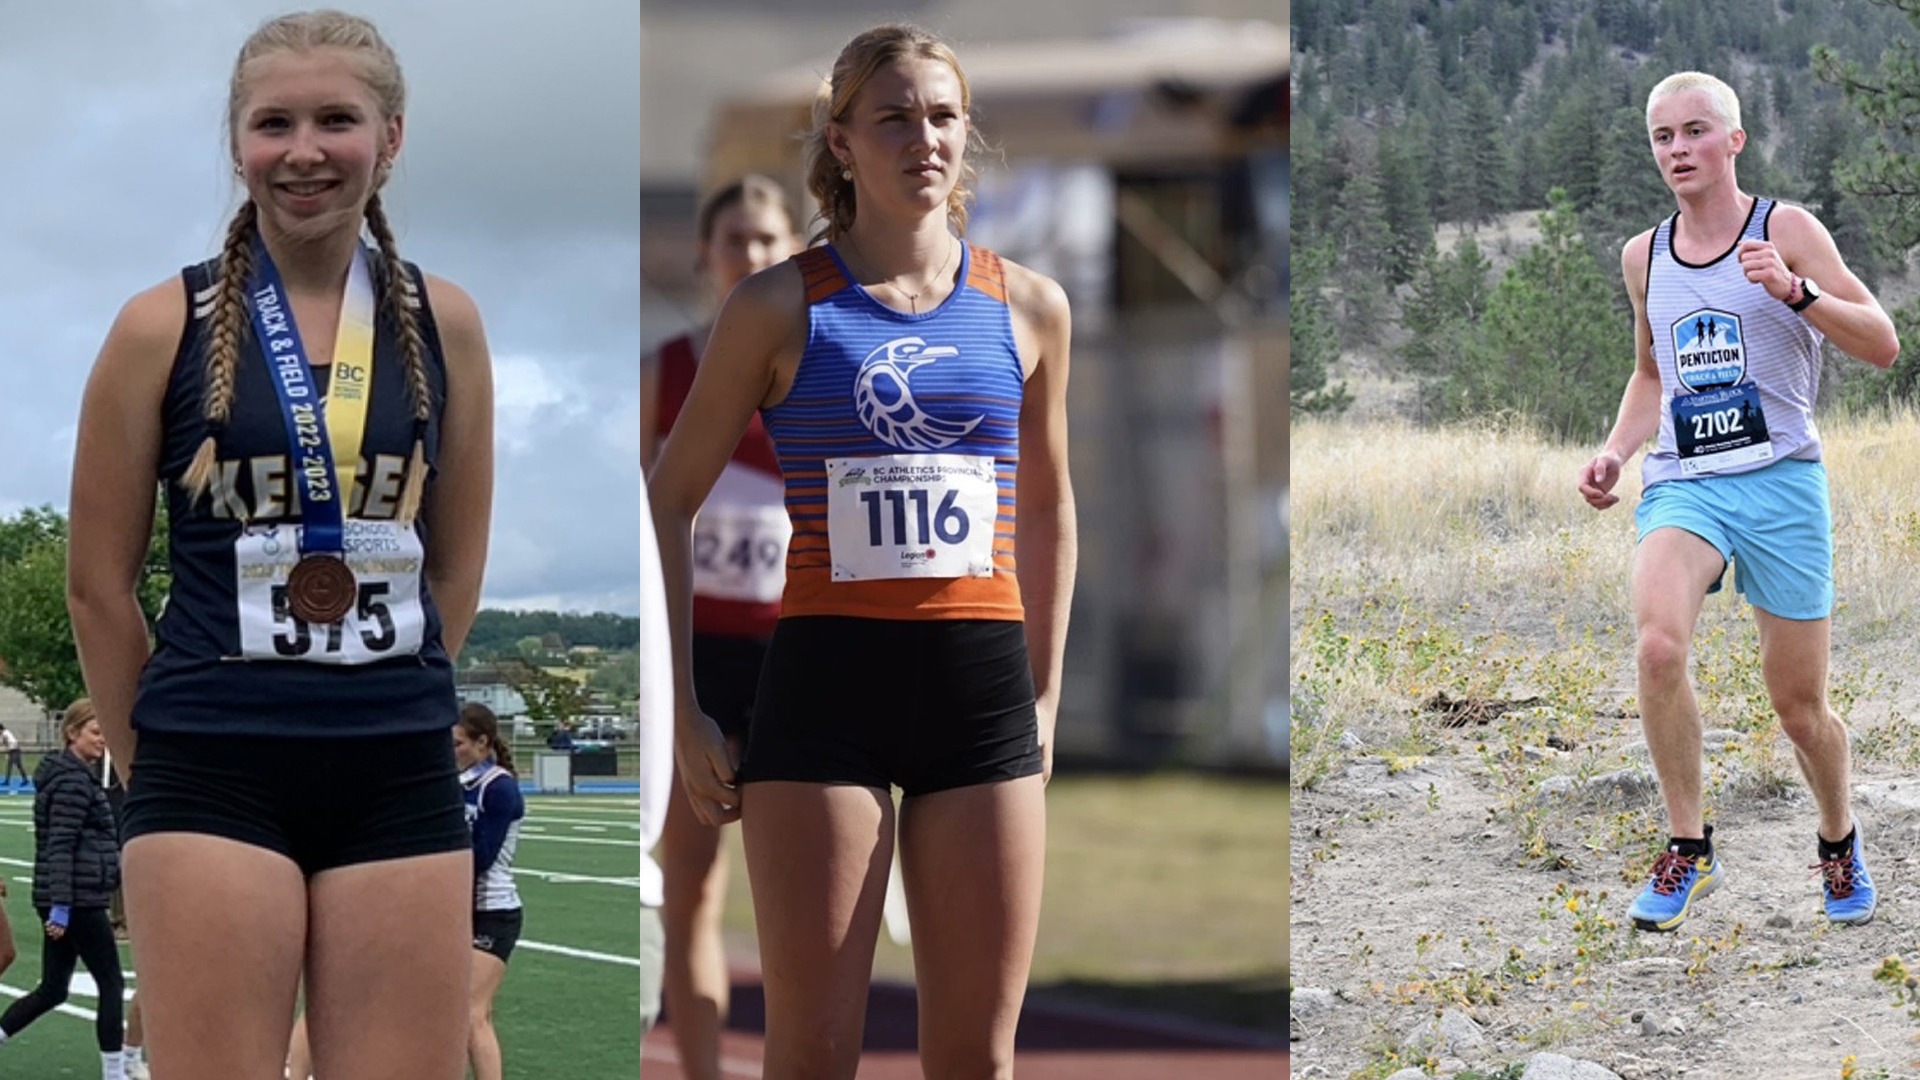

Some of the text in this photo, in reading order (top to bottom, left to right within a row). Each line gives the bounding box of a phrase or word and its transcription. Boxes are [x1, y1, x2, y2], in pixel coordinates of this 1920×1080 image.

[1679, 348, 1740, 368] PENTICTON
[336, 362, 364, 382] BC
[254, 283, 332, 501] TRACK & FIELD 2022-2023
[1692, 408, 1744, 439] 2702
[873, 467, 885, 475] BC
[888, 466, 934, 474] ATHLETICS
[860, 489, 970, 547] 1116
[343, 521, 395, 537] SCHOOL
[343, 538, 400, 553] SPORTS
[901, 551, 925, 560] Legion
